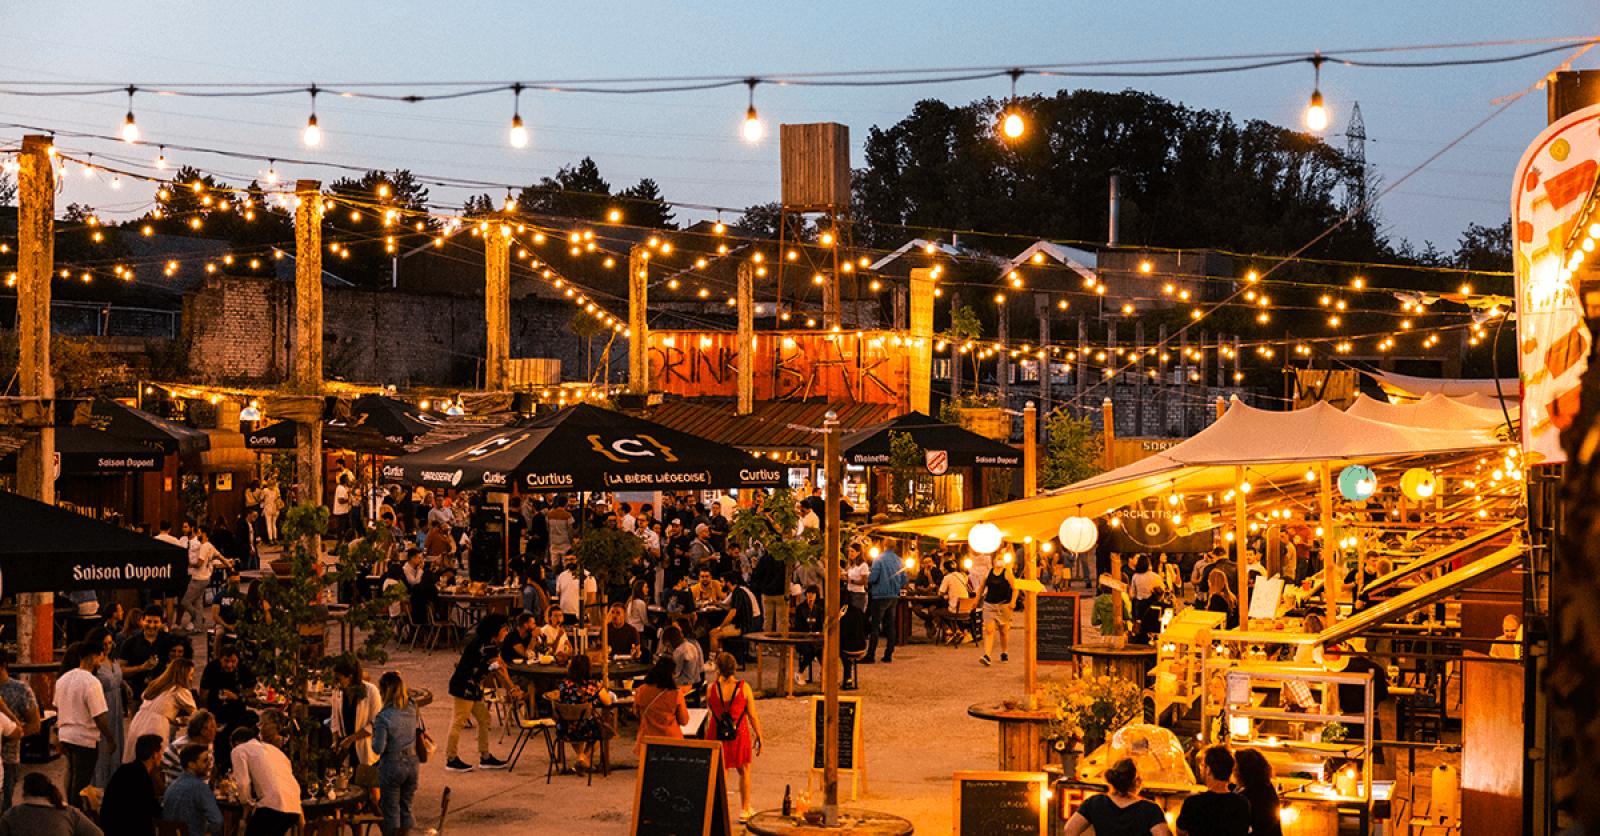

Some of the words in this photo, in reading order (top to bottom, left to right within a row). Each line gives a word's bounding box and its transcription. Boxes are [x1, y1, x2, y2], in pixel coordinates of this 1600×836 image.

[250, 436, 277, 445] Curtius
[98, 458, 125, 467] Saison
[126, 458, 154, 468] Dupont
[975, 456, 996, 464] Saison
[997, 456, 1019, 464] Dupont
[526, 473, 573, 485] Curtius
[625, 471, 652, 484] BIÈRE
[739, 469, 780, 481] Curtius
[73, 564, 120, 581] Saison
[124, 563, 172, 581] Dupont
